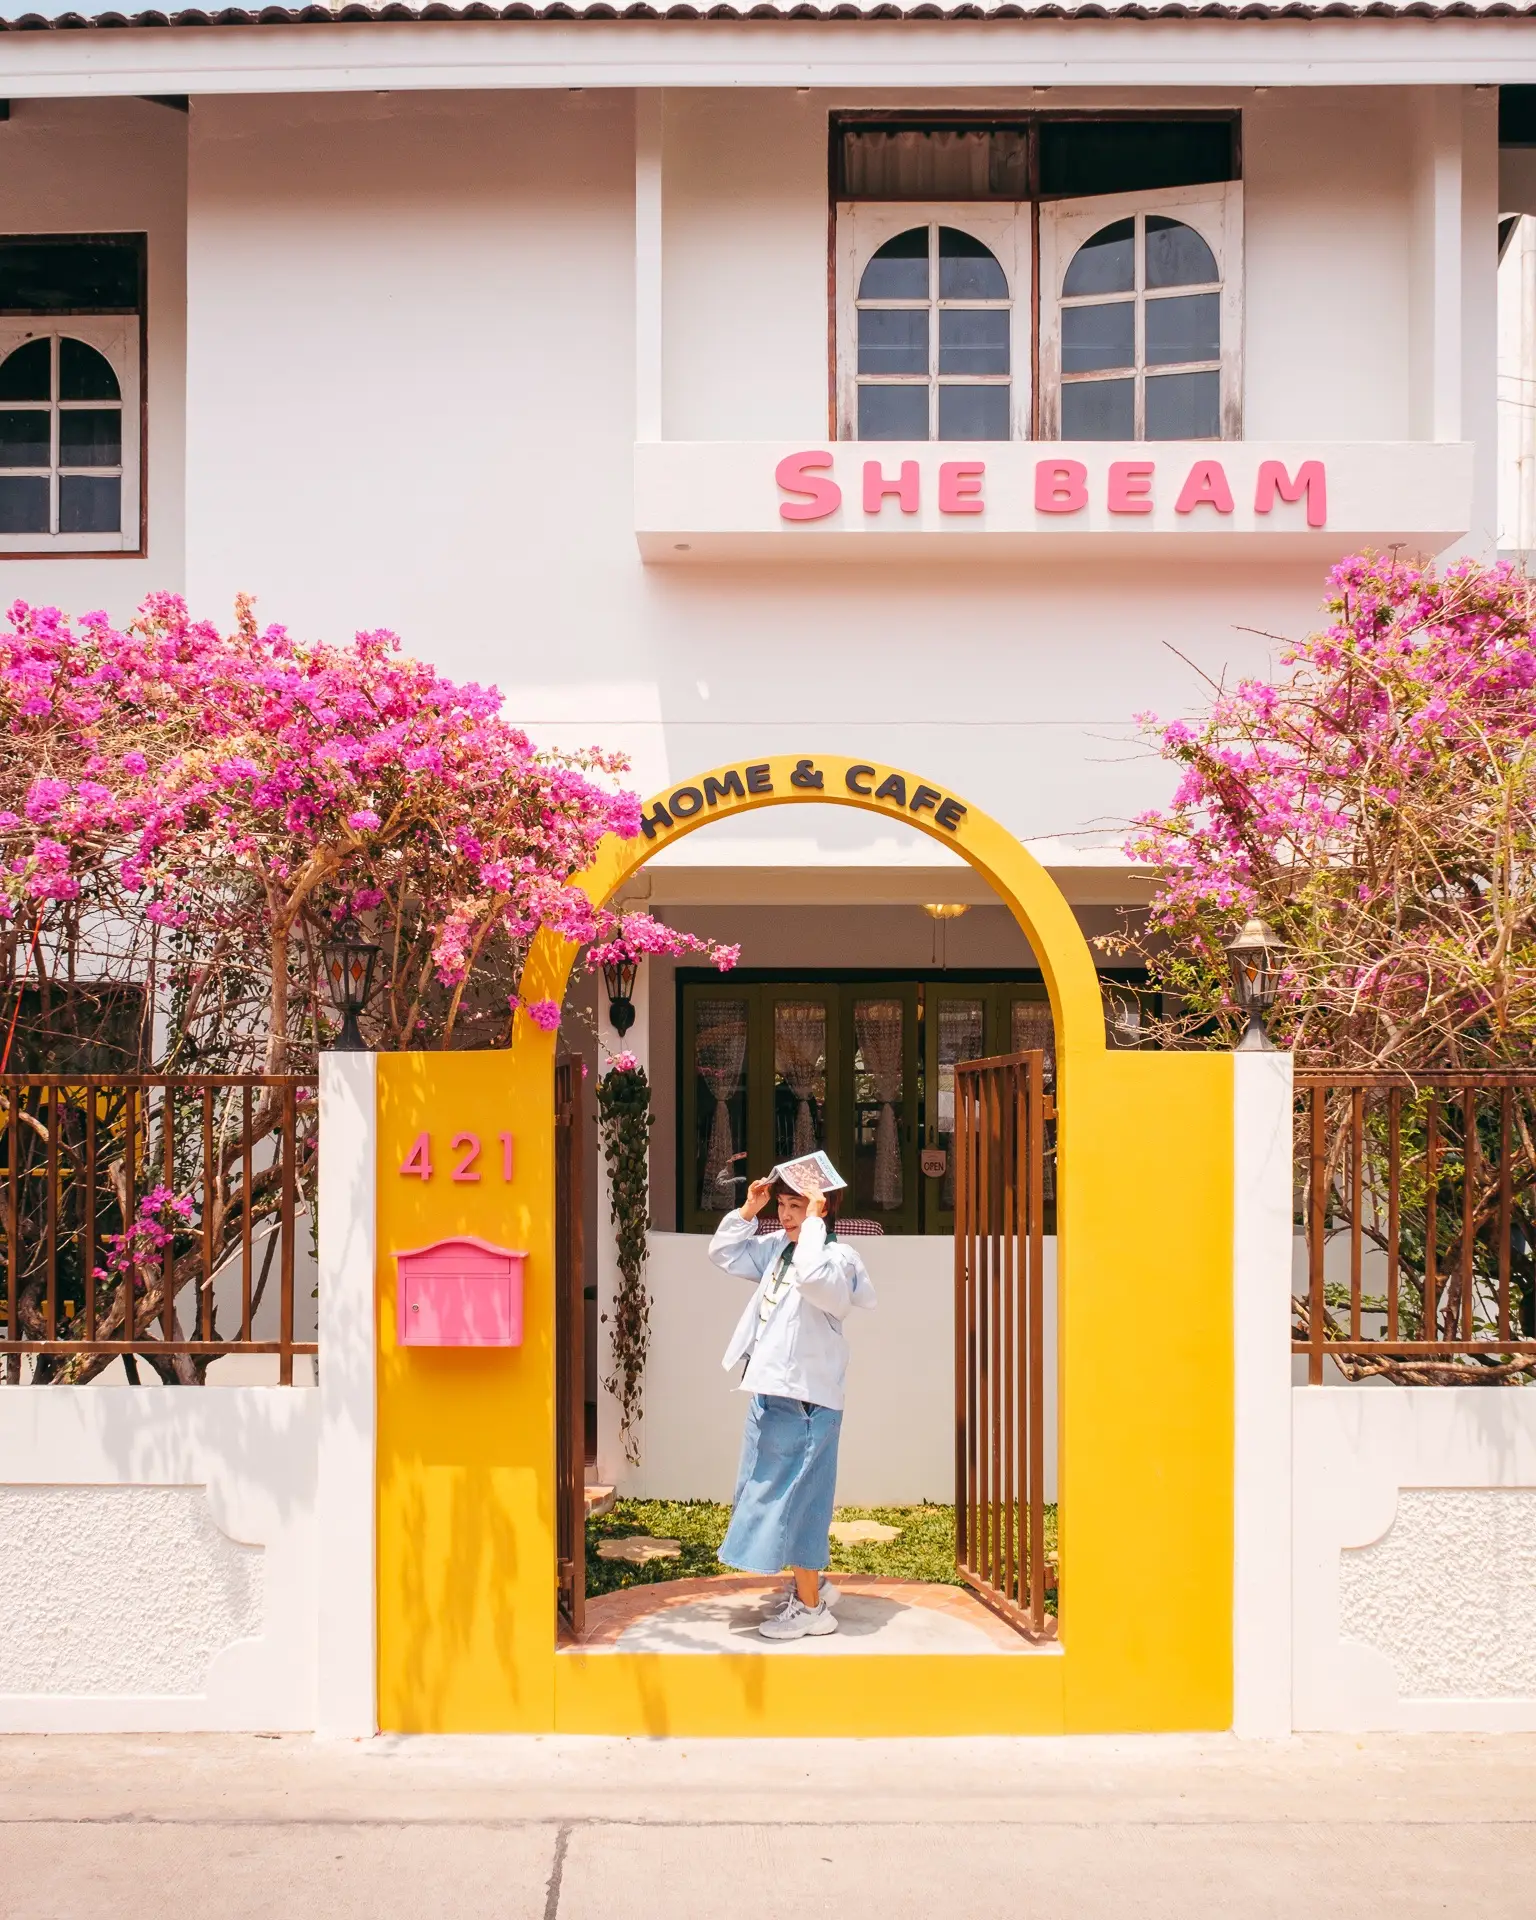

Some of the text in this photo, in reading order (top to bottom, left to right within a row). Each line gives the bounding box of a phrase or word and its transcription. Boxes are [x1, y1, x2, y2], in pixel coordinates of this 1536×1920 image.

[775, 451, 1327, 527] SHE BEAM
[640, 759, 968, 839] HOME & CAFE
[400, 1131, 513, 1181] 421
[923, 1161, 944, 1171] OPEN
